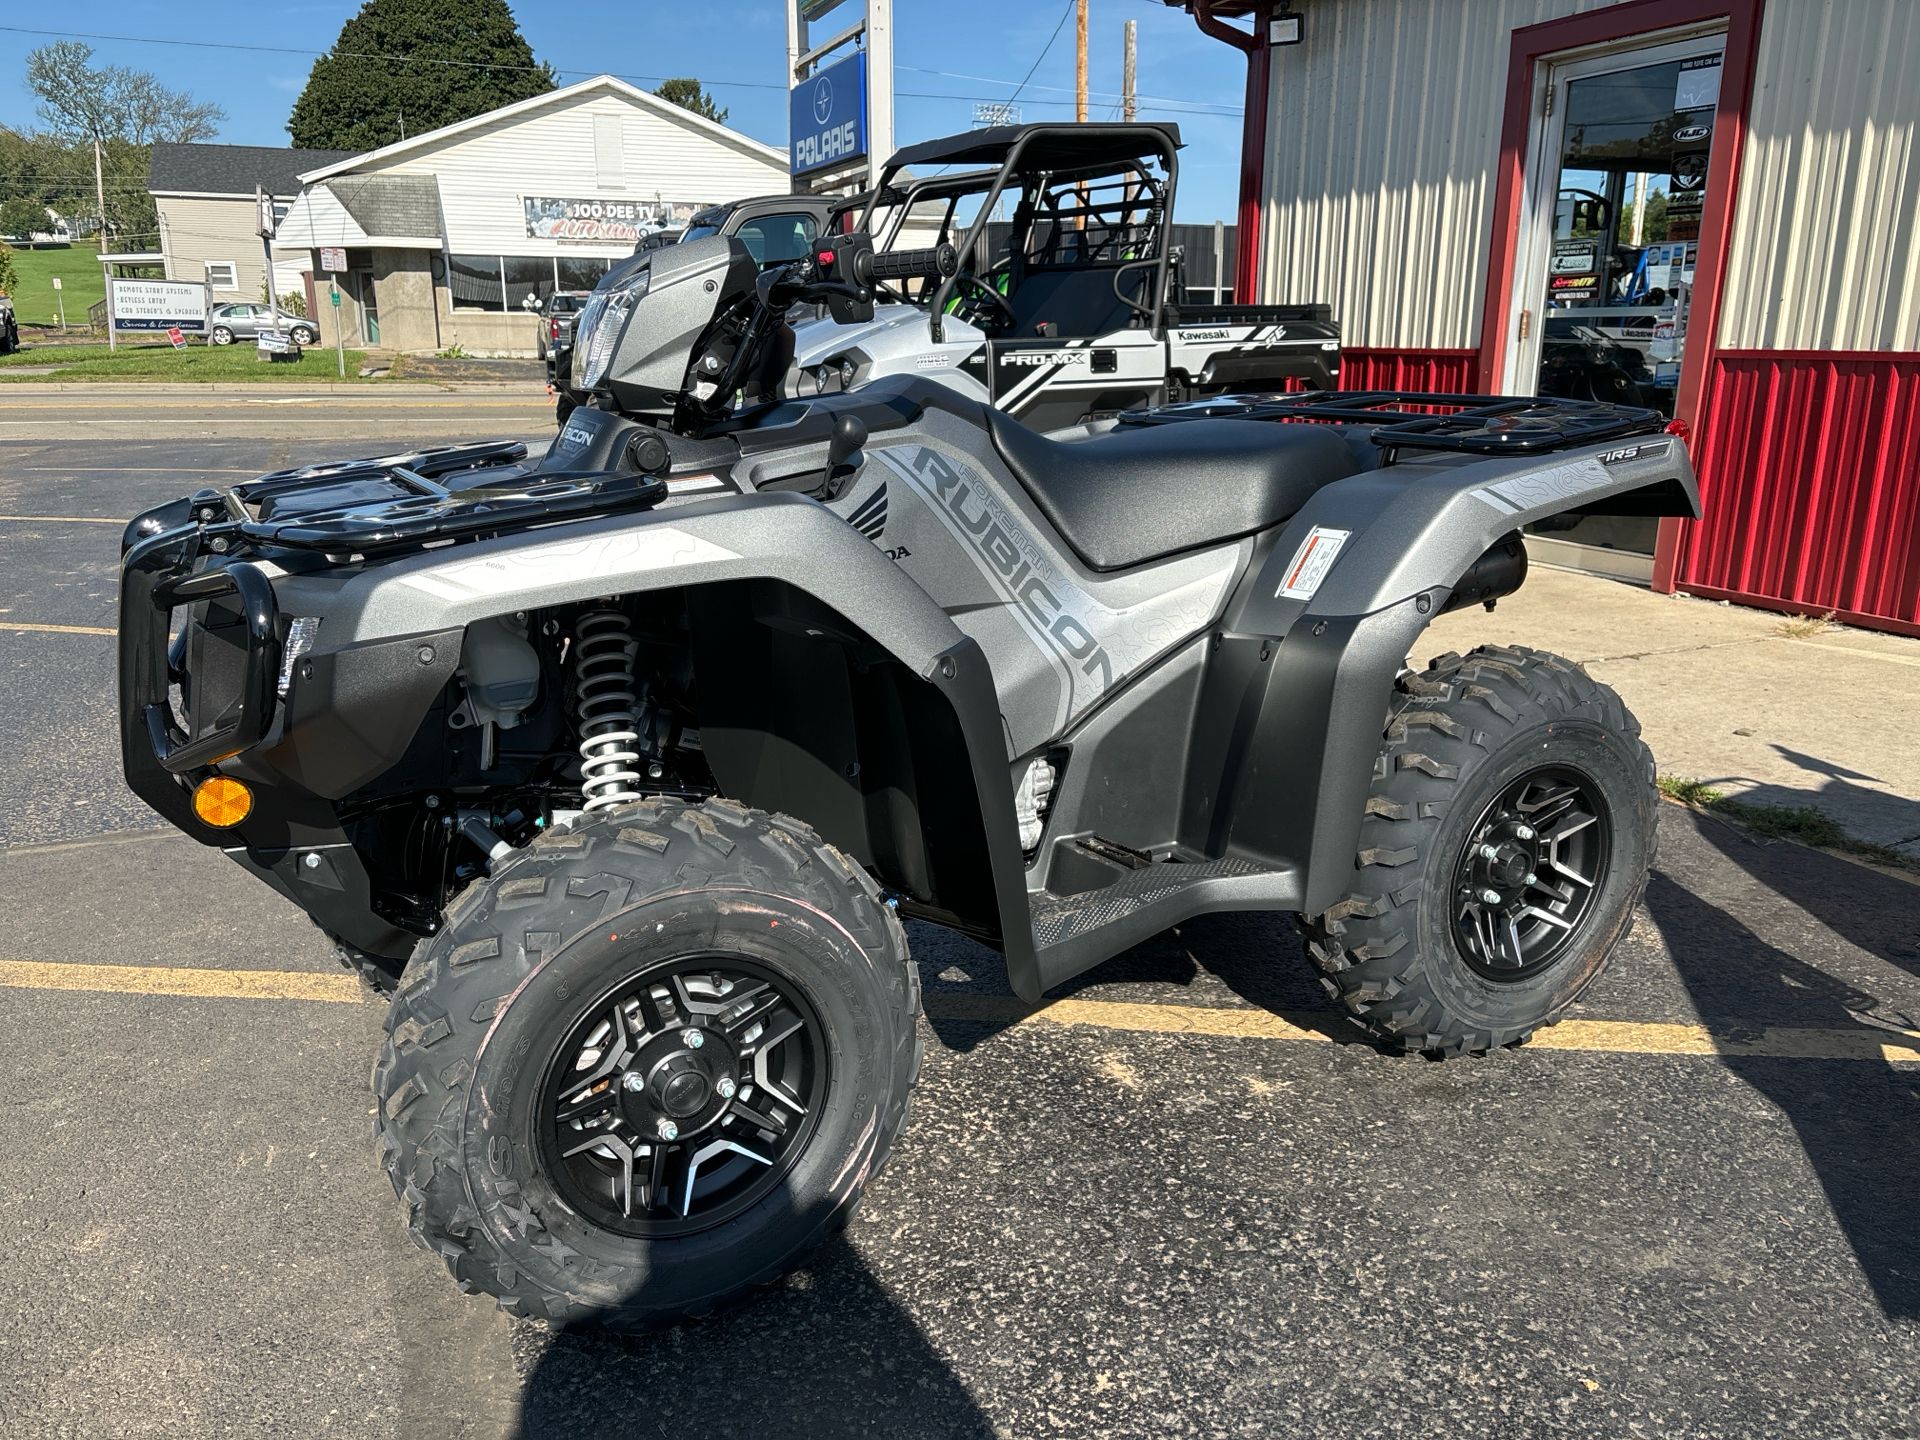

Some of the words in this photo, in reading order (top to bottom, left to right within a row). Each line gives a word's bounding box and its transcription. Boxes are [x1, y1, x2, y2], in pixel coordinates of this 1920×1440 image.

[1679, 128, 1705, 138] HJC
[796, 120, 856, 169] POLARIS
[637, 206, 656, 220] TV
[1178, 329, 1230, 341] Kawasaki
[1000, 353, 1086, 366] PRO-MX
[1605, 448, 1638, 462] IRS
[957, 463, 1053, 581] FOREMAN
[912, 446, 1113, 693] RUBICON
